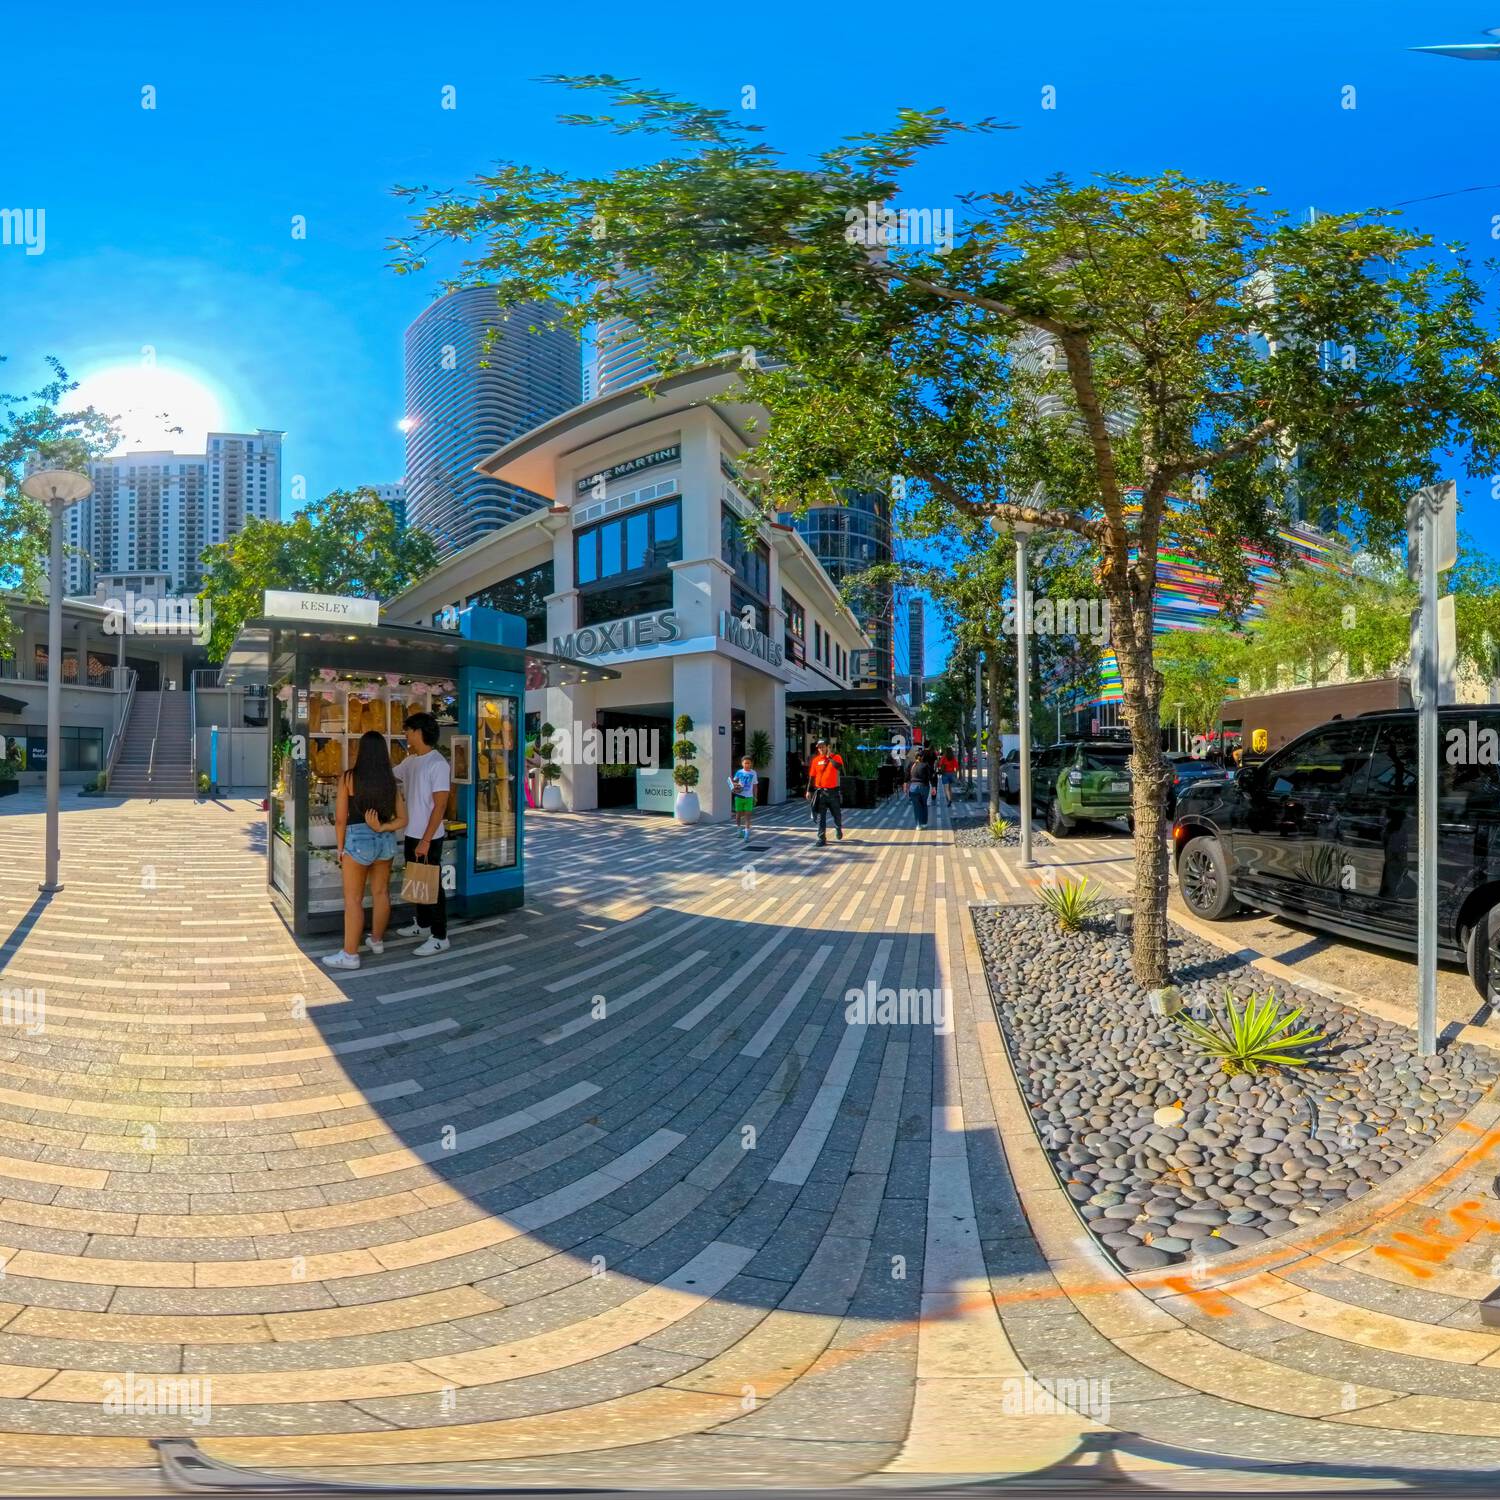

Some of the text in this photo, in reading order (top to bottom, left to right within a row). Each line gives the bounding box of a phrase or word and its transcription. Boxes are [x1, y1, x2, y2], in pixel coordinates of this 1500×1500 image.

[614, 447, 677, 475] MARTINI
[301, 600, 349, 614] KESLEY
[552, 611, 681, 658] MOXIES
[721, 611, 783, 667] MOXIES
[645, 788, 672, 797] MOXIES
